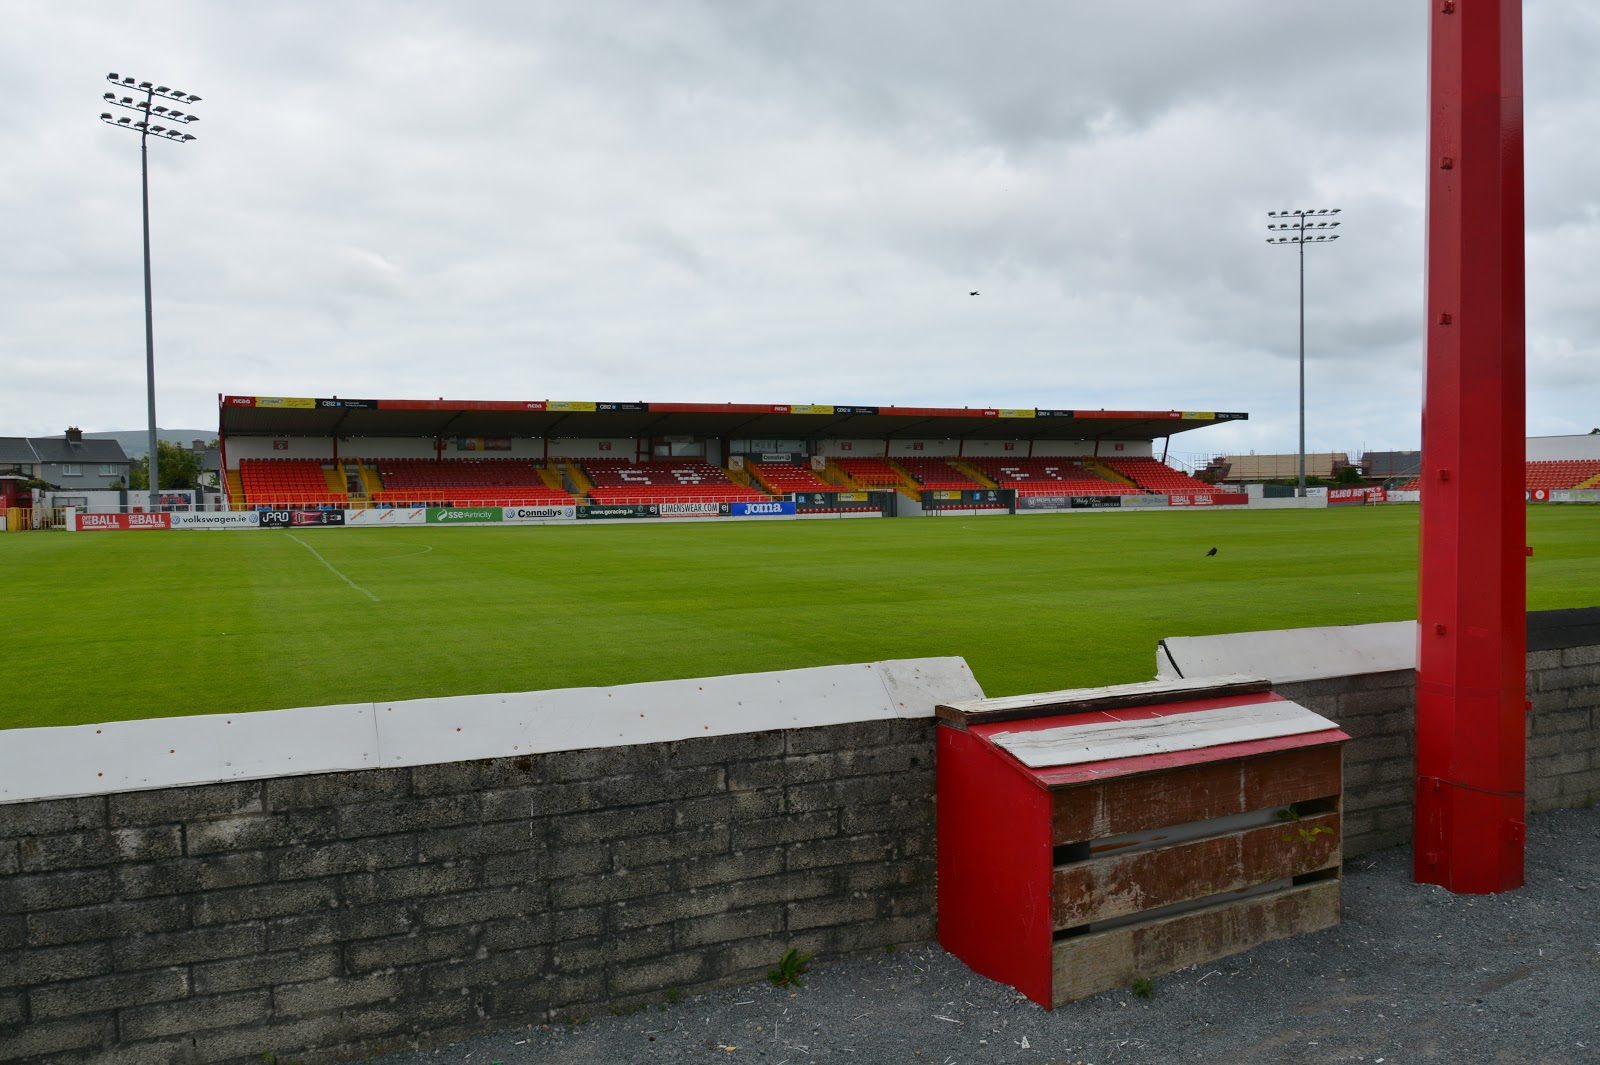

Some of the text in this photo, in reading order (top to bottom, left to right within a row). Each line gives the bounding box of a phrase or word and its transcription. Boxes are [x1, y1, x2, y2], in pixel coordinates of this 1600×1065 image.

[1330, 488, 1352, 498] SLIGO
[517, 508, 562, 518] Connollys
[590, 508, 633, 516] www.goracing.ie
[649, 505, 658, 514] ej
[661, 503, 718, 513] EJMENSWEAR.COM
[91, 515, 119, 525] BALL
[138, 514, 165, 524] BALL
[183, 514, 247, 525] volkswagen.ie
